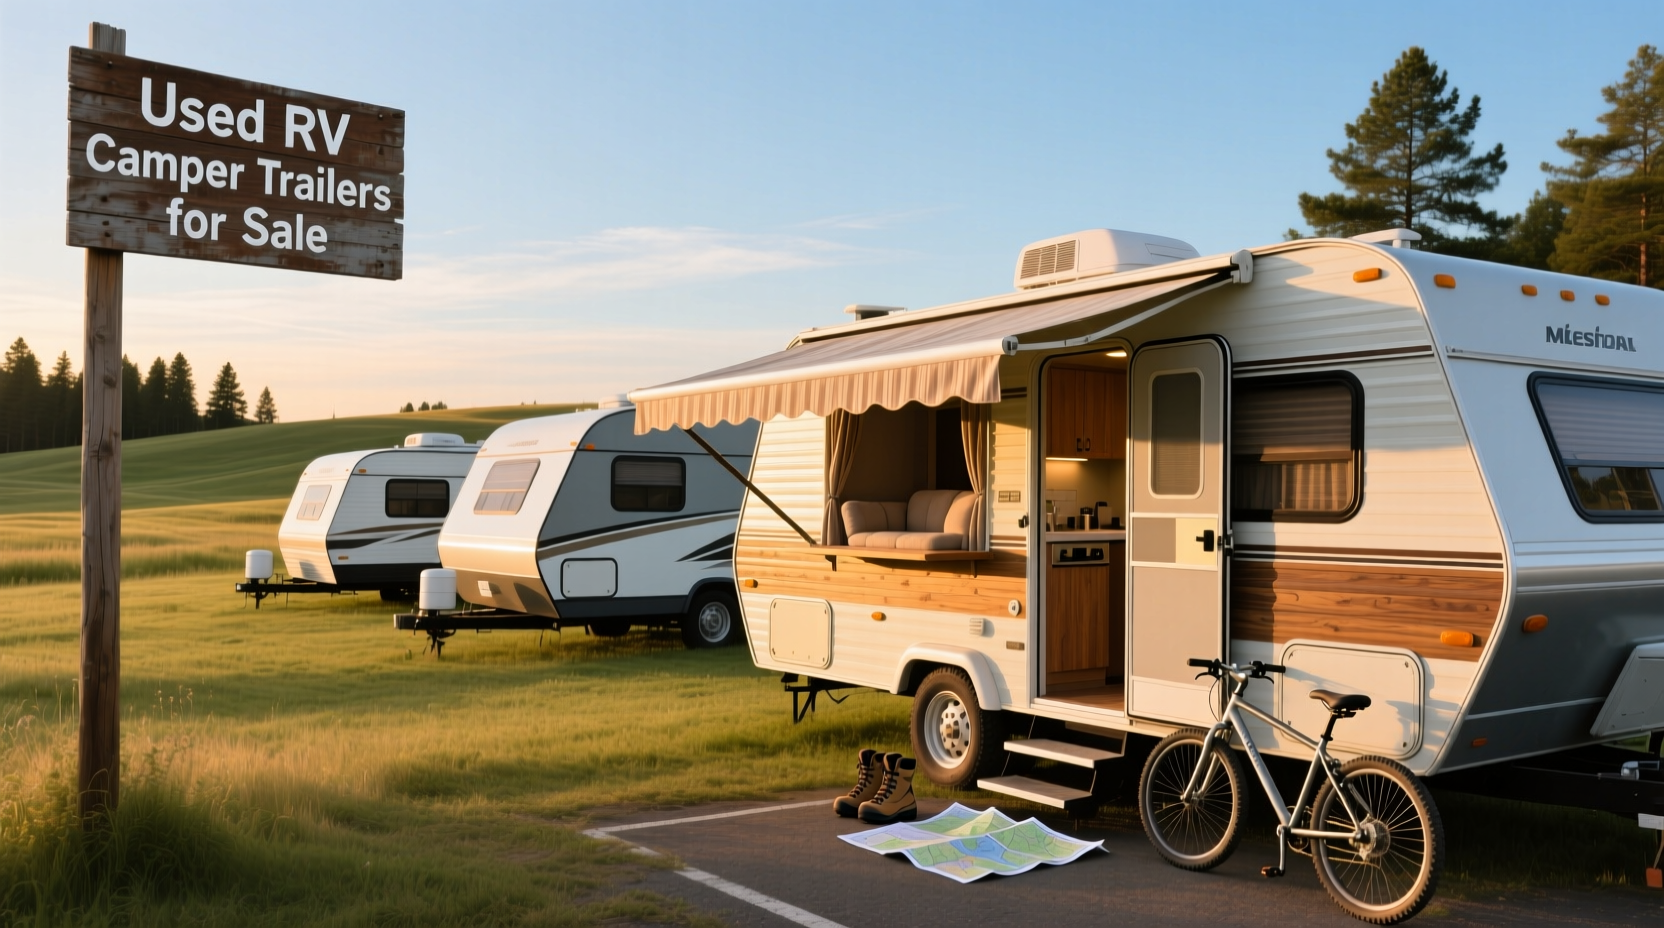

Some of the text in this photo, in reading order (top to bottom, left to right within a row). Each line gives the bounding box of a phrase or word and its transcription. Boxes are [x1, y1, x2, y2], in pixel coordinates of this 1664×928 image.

[141, 77, 350, 155] Used RV
[86, 133, 391, 212] Camper Trailers
[166, 197, 328, 253] for Sale
